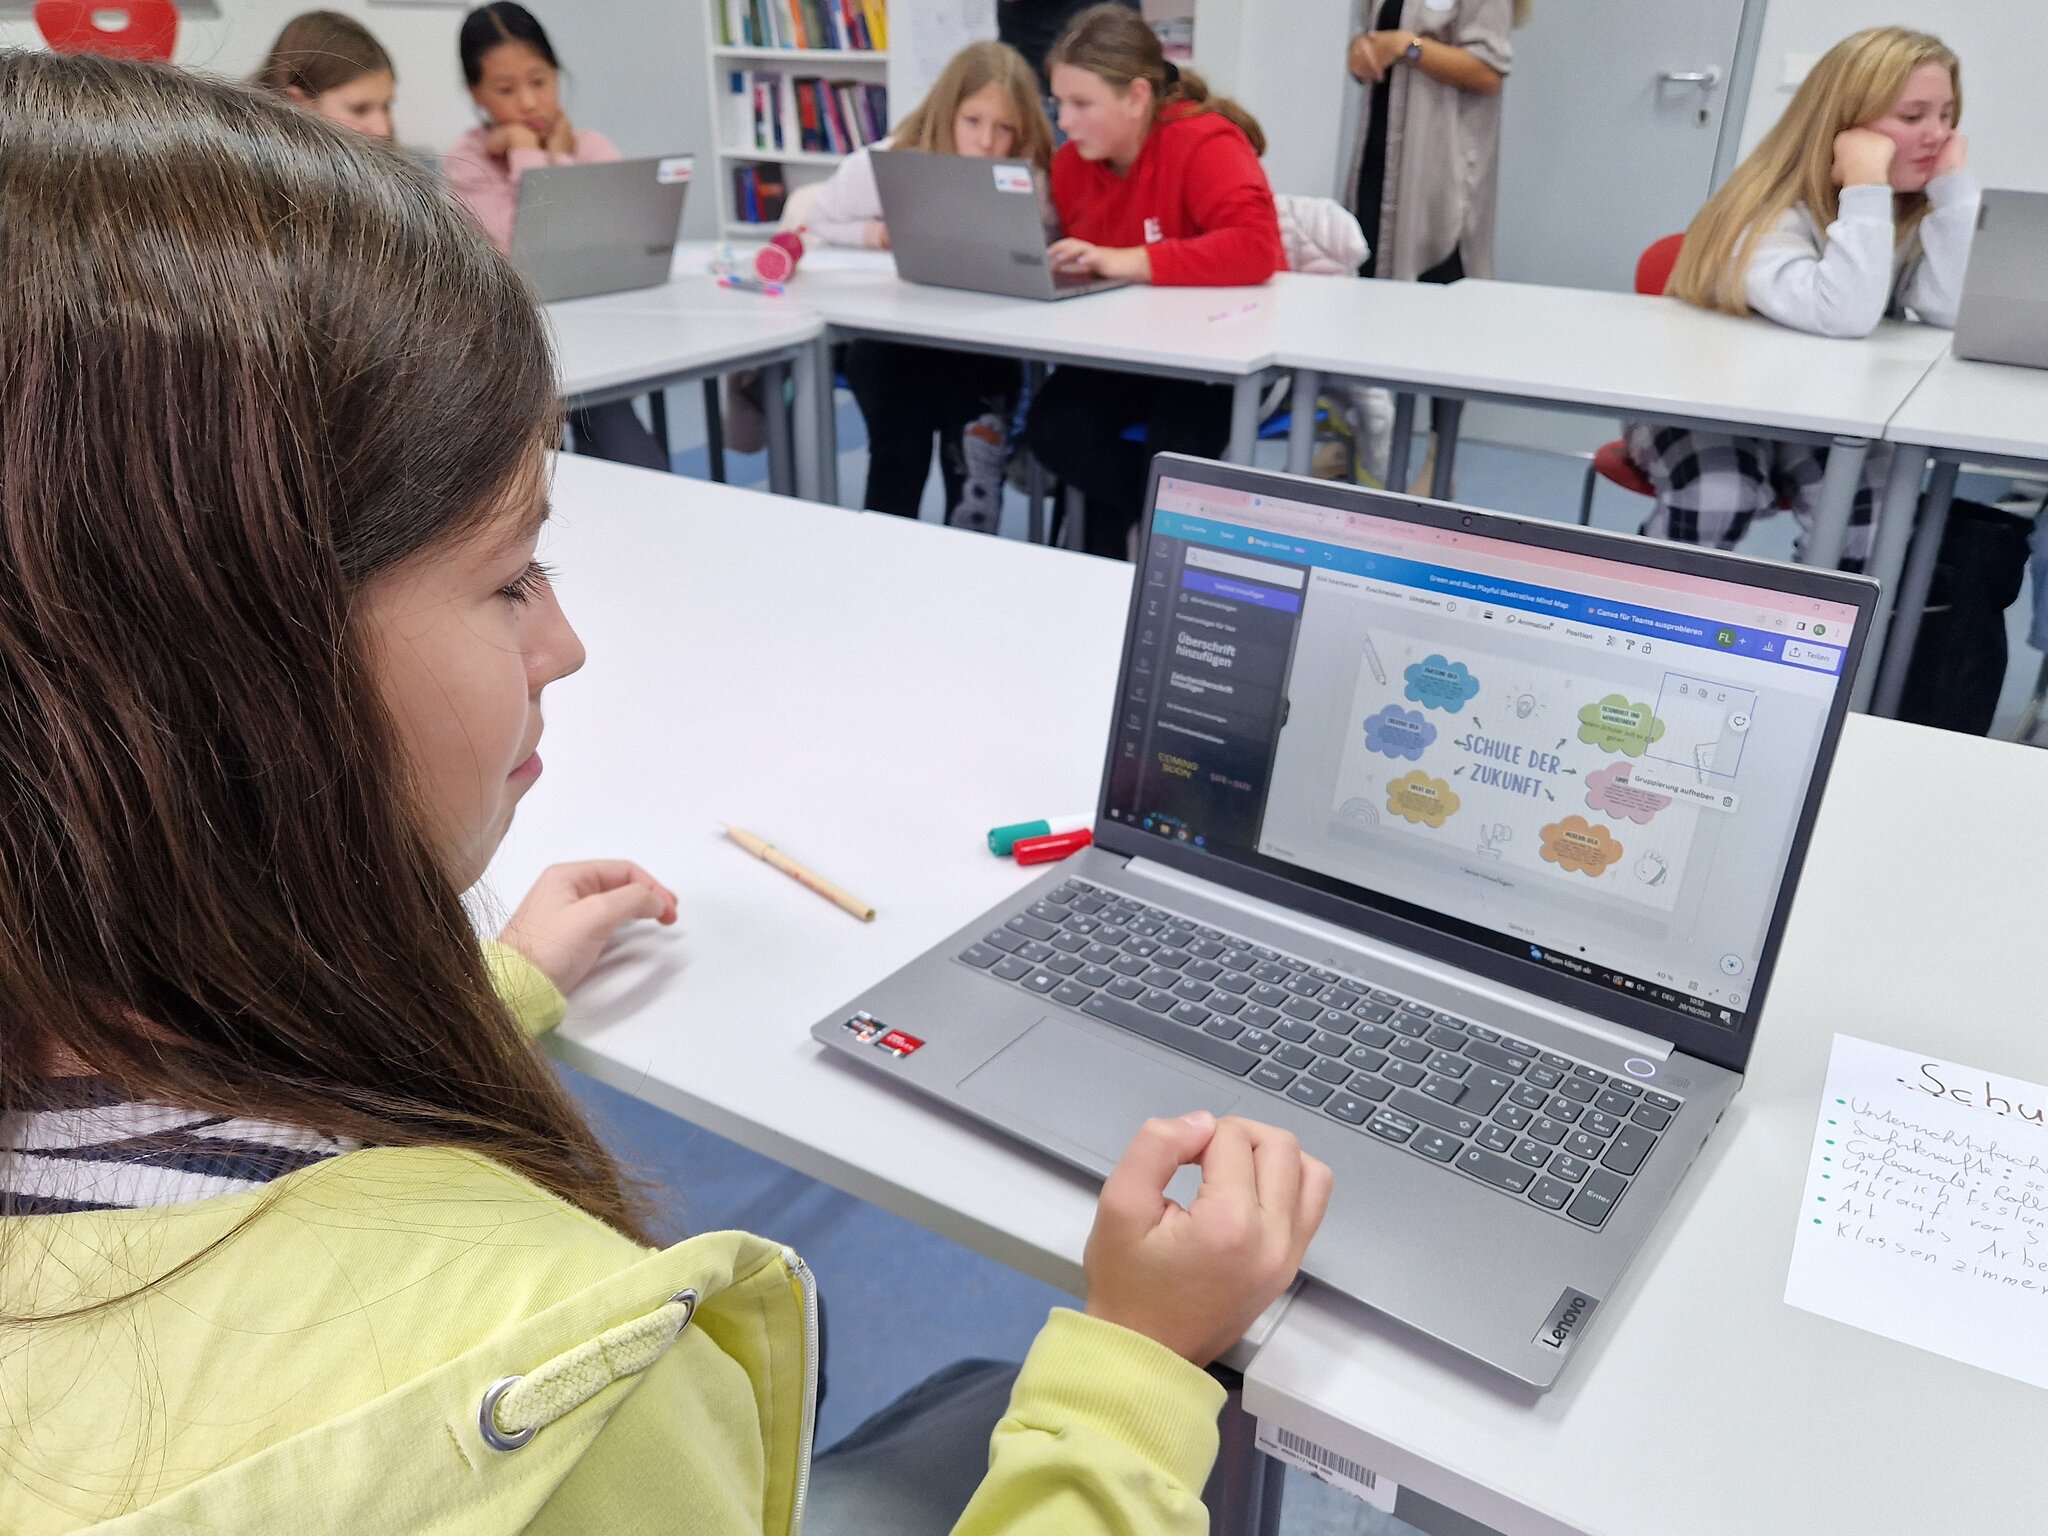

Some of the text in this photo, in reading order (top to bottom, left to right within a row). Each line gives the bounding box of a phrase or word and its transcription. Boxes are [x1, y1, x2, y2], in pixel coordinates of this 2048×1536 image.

[1517, 618, 1551, 631] Animation
[1566, 628, 1593, 640] Position
[1597, 608, 1703, 636] Canva für Teams ausprobieren
[1178, 631, 1236, 657] Überschrift
[1718, 631, 1731, 643] FL
[1176, 644, 1232, 667] hinzufügen
[1806, 651, 1830, 662] Teilen
[1463, 733, 1560, 775] SCHULE DER
[1470, 763, 1542, 798] ZUKUNFT
[1634, 775, 1679, 793] Gruppierung
[1680, 785, 1715, 801] aufheben
[1918, 1063, 2044, 1123] Schu
[1586, 1190, 1611, 1203] Enter
[1837, 1200, 1876, 1219] Art
[1913, 1220, 1951, 1243] des
[1542, 1297, 1586, 1348] Lenovo
